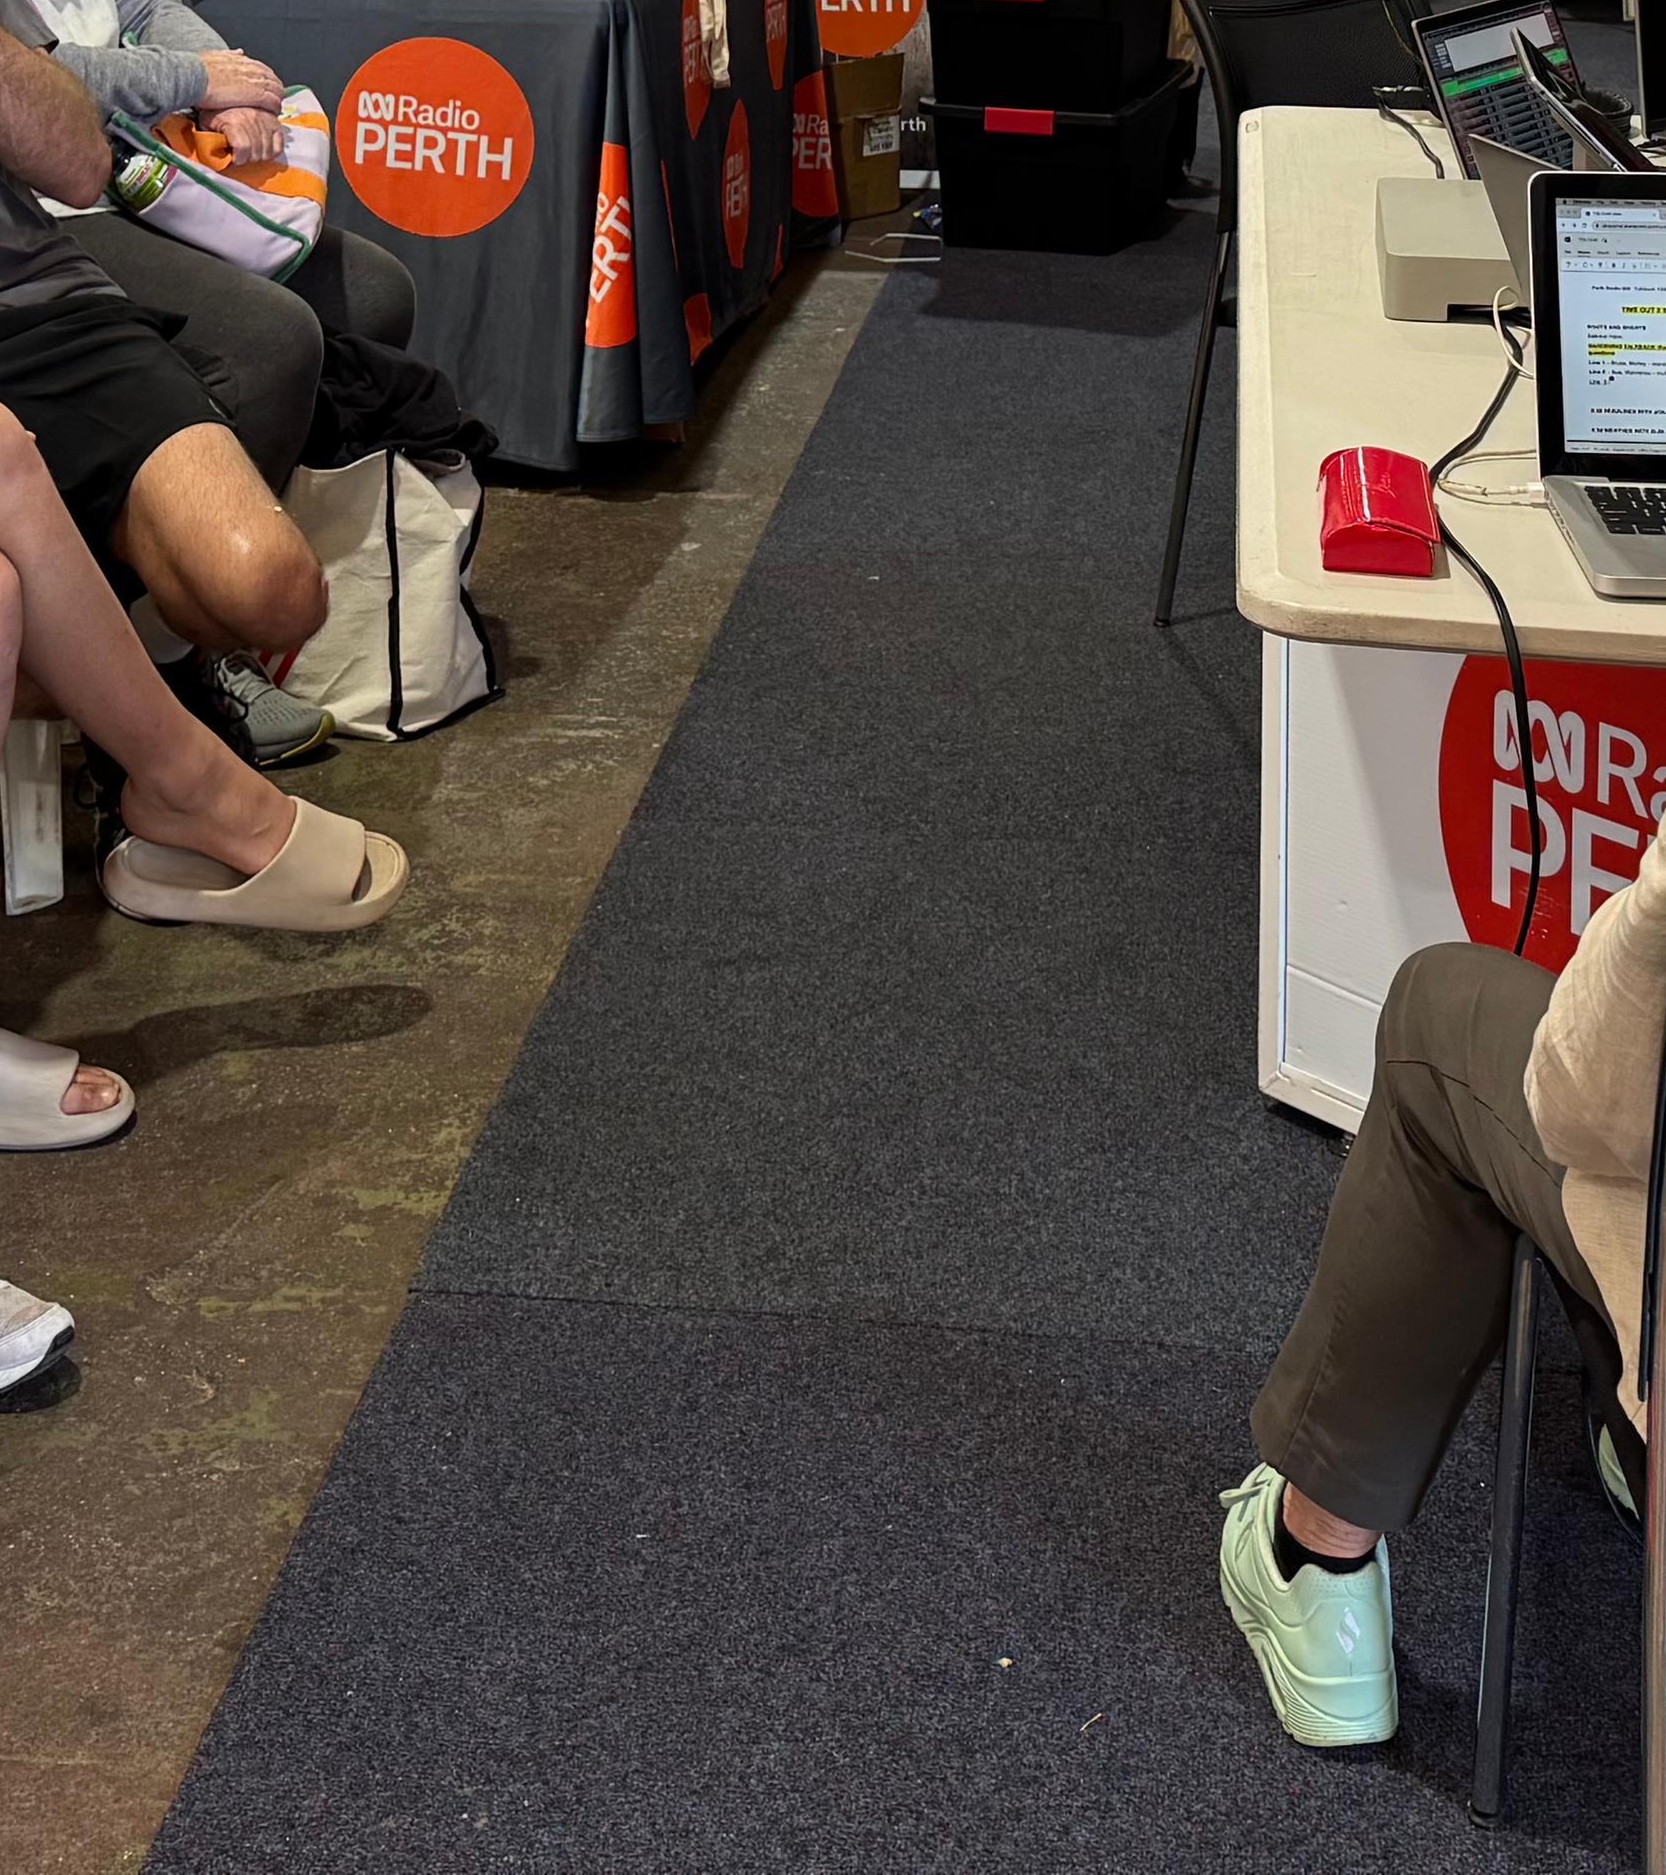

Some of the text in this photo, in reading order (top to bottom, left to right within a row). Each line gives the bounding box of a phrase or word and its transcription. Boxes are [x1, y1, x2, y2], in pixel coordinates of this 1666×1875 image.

[398, 95, 480, 130] Radio
[901, 117, 926, 132] rth
[355, 121, 513, 181] PERTH
